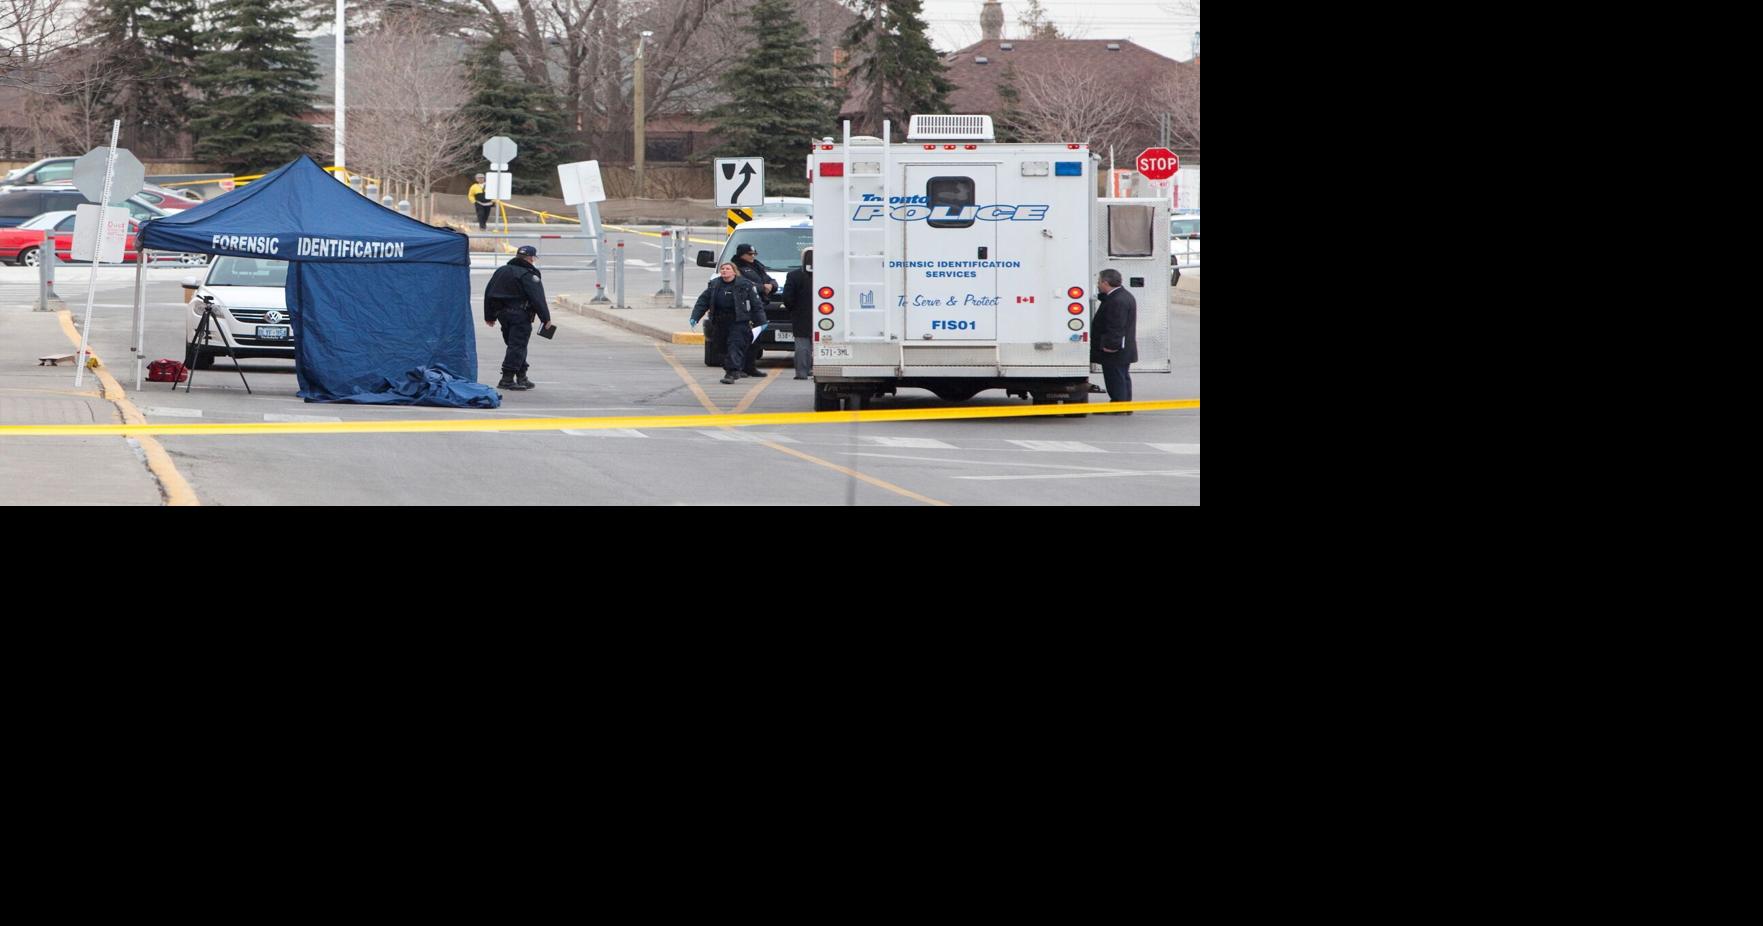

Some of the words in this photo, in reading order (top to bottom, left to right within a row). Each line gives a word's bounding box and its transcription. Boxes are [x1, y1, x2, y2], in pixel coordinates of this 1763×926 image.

[1140, 158, 1176, 171] STOP
[862, 193, 930, 204] Toonto
[853, 204, 1050, 221] POLICE
[212, 234, 279, 254] FORENSIC
[297, 237, 404, 258] IDENTIFICATION
[912, 294, 942, 307] Serve
[946, 296, 958, 306] &
[963, 294, 1002, 306] Protect
[931, 320, 977, 330] FIS01
